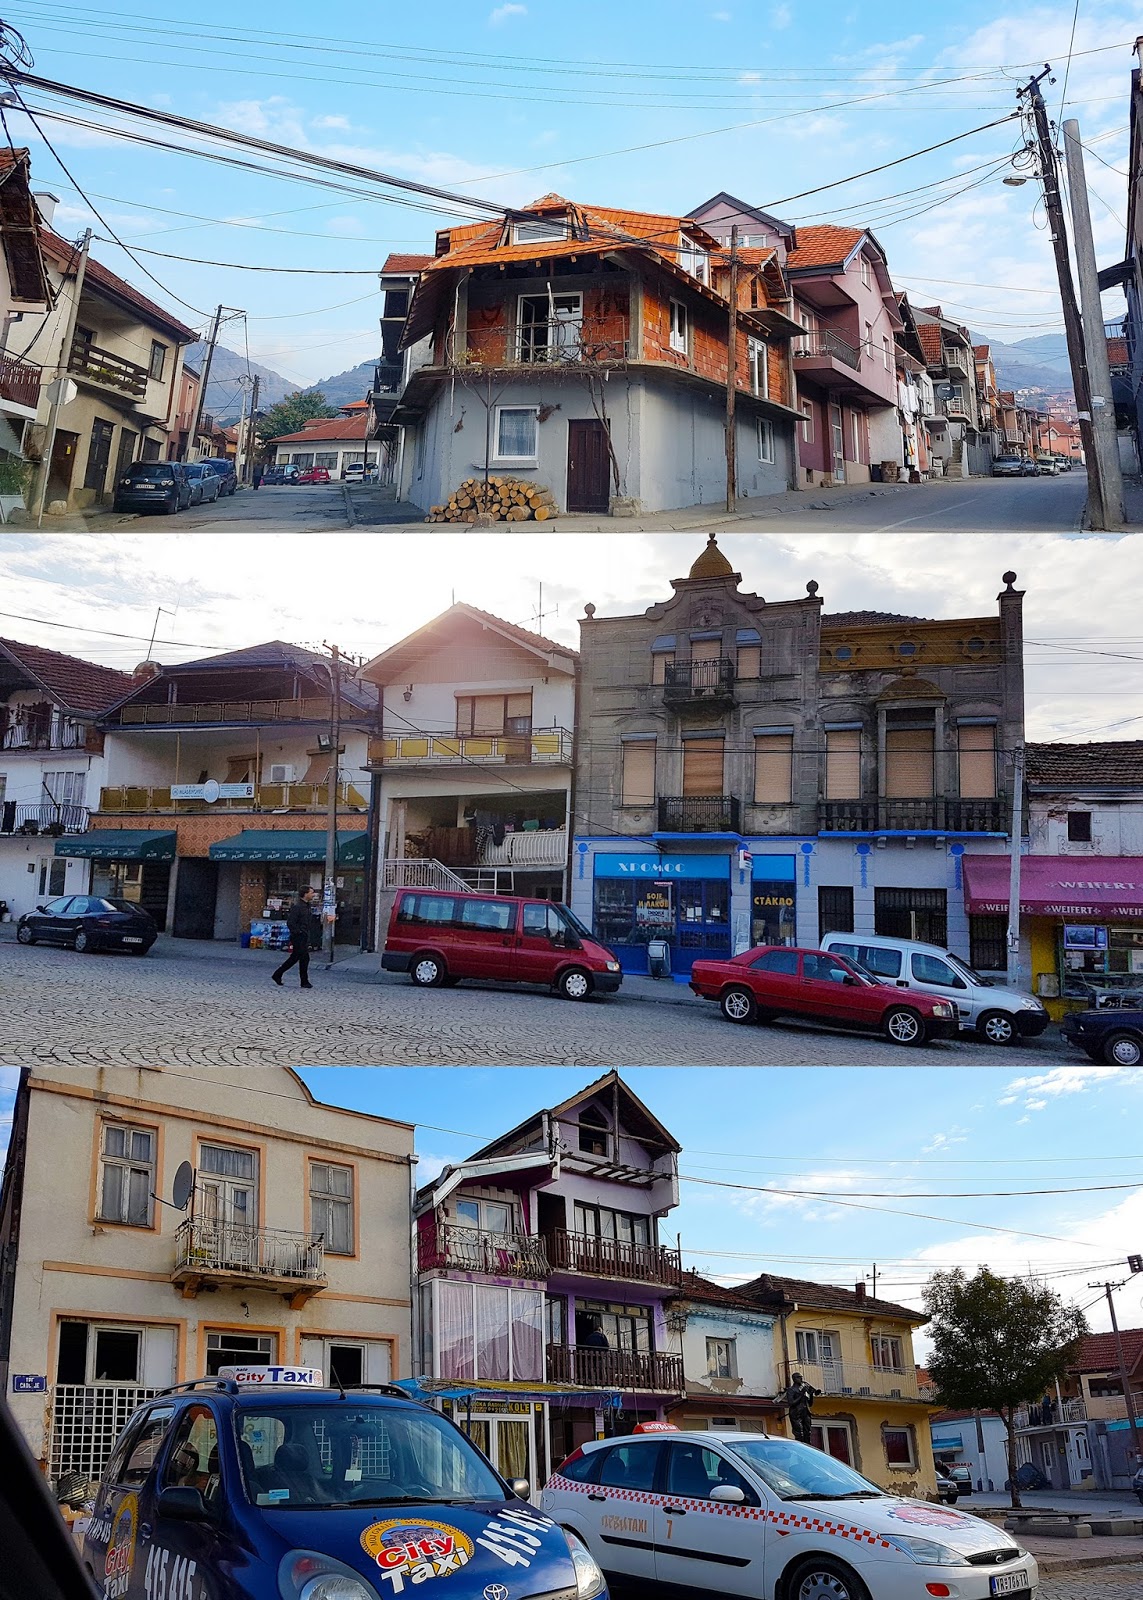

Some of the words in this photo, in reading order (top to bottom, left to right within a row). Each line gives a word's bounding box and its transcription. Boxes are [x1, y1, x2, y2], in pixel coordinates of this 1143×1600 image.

[618, 863, 686, 872] ХРОМОС
[1058, 881, 1135, 890] WEIFERT
[753, 897, 794, 906] СТАКЛО
[1051, 905, 1093, 914] WEIFERT
[235, 1372, 266, 1383] City
[268, 1367, 313, 1384] Taxi
[476, 1522, 541, 1568] 415
[375, 1536, 454, 1570] City
[380, 1549, 469, 1594] Taxi
